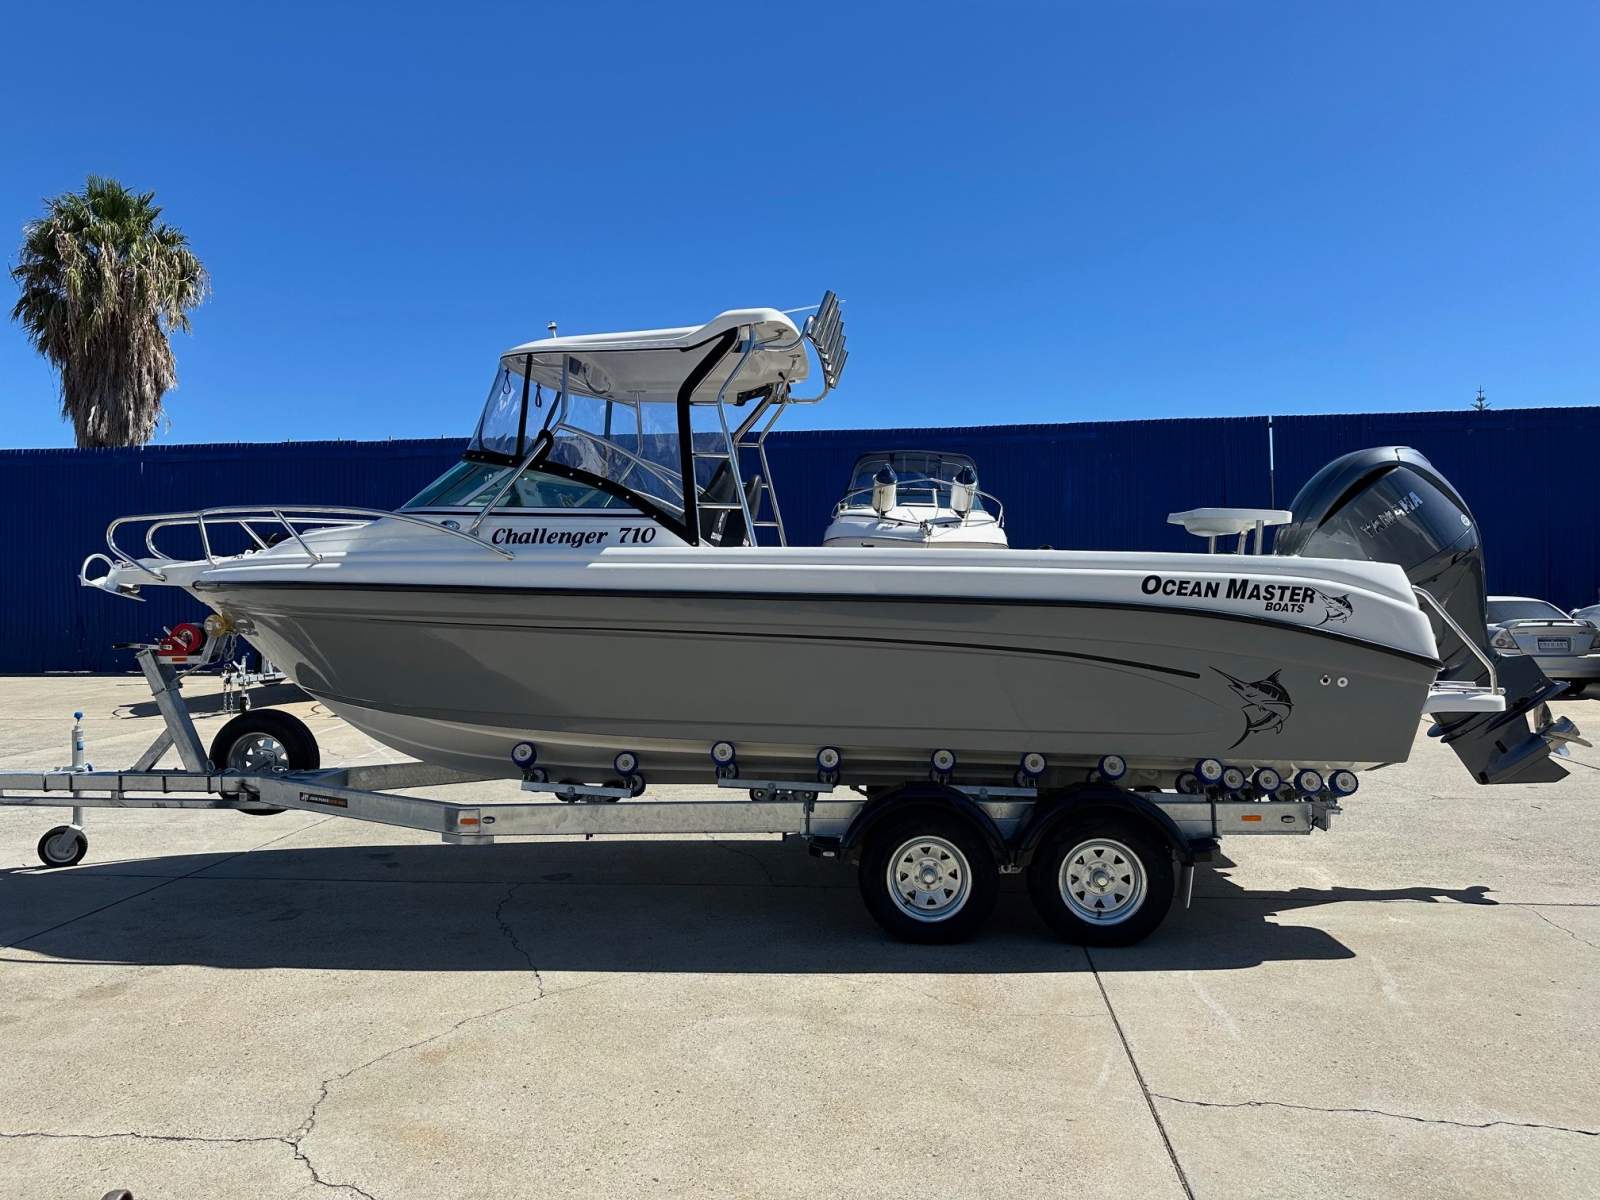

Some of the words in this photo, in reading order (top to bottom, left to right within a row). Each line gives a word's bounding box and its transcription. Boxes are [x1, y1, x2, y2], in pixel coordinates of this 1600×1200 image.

[1360, 491, 1423, 538] YAMAHA
[491, 527, 609, 548] Challenger
[619, 527, 656, 544] 710
[1141, 575, 1221, 599] OCEAN
[1226, 578, 1316, 604] MASTER
[1265, 602, 1305, 614] BOATS
